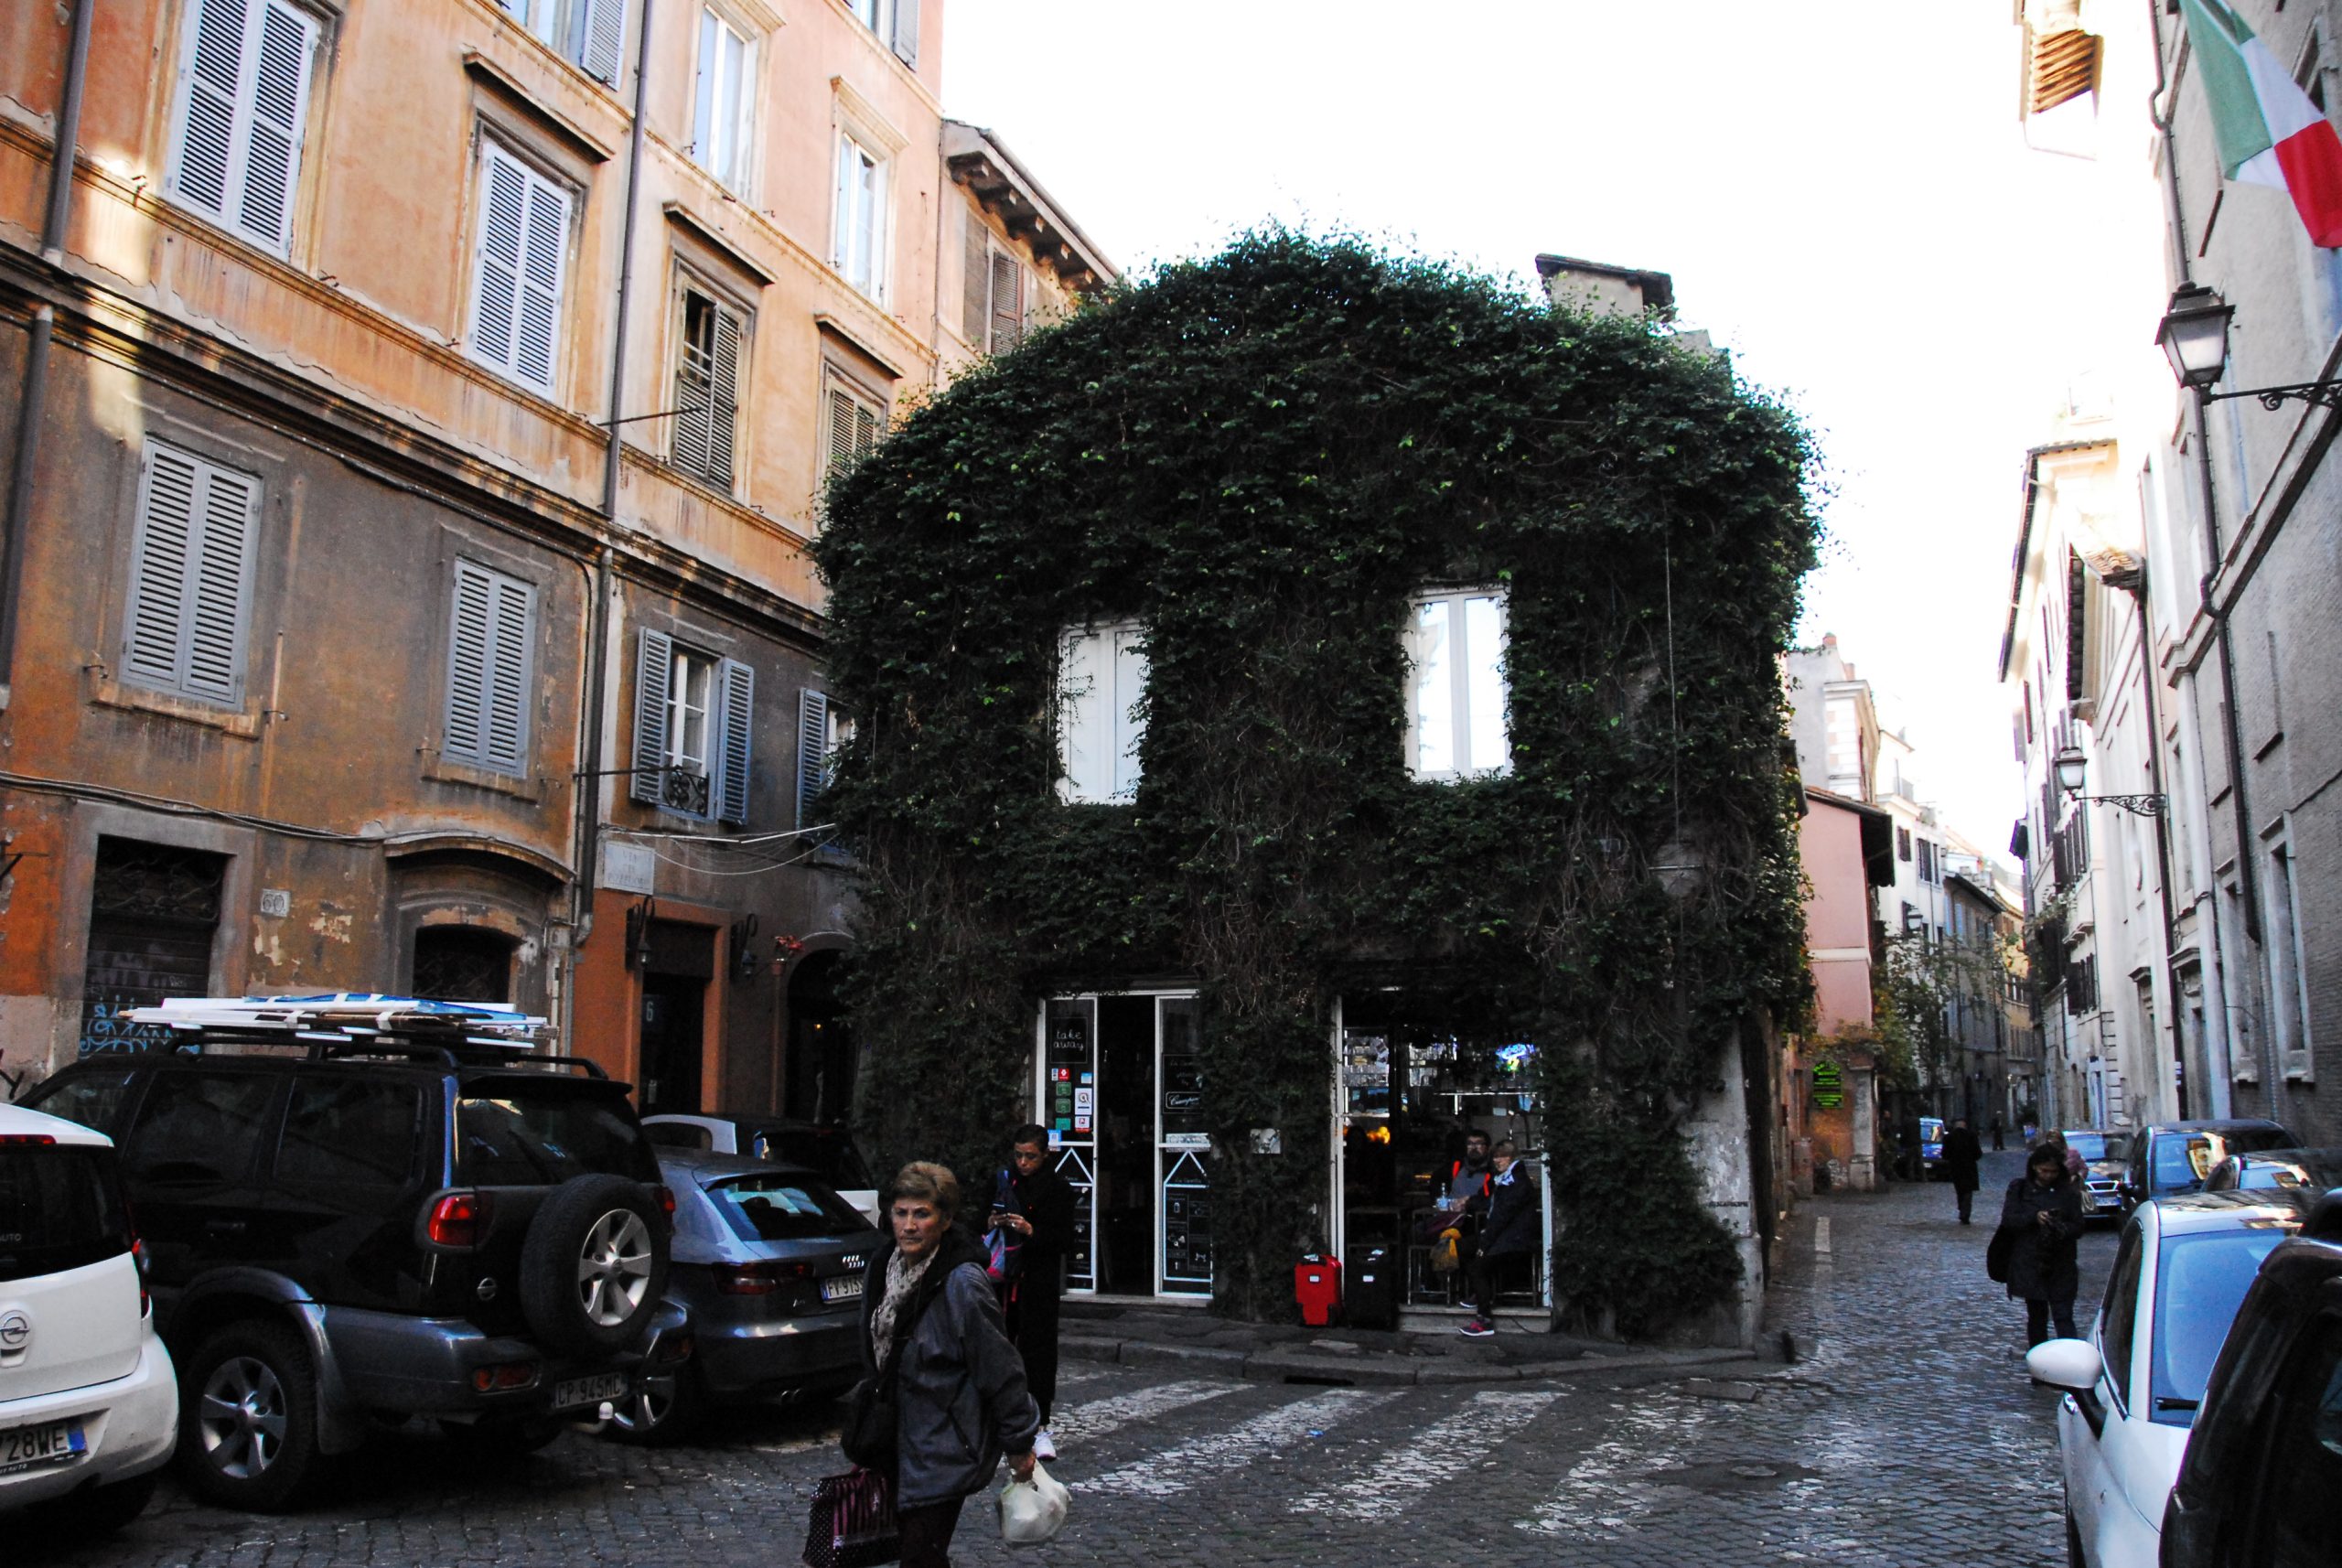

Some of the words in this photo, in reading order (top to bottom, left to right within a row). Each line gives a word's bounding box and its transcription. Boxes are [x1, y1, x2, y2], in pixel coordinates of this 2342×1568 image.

[646, 1001, 654, 1022] 6
[1057, 1029, 1082, 1040] take
[1053, 1041, 1084, 1051] away
